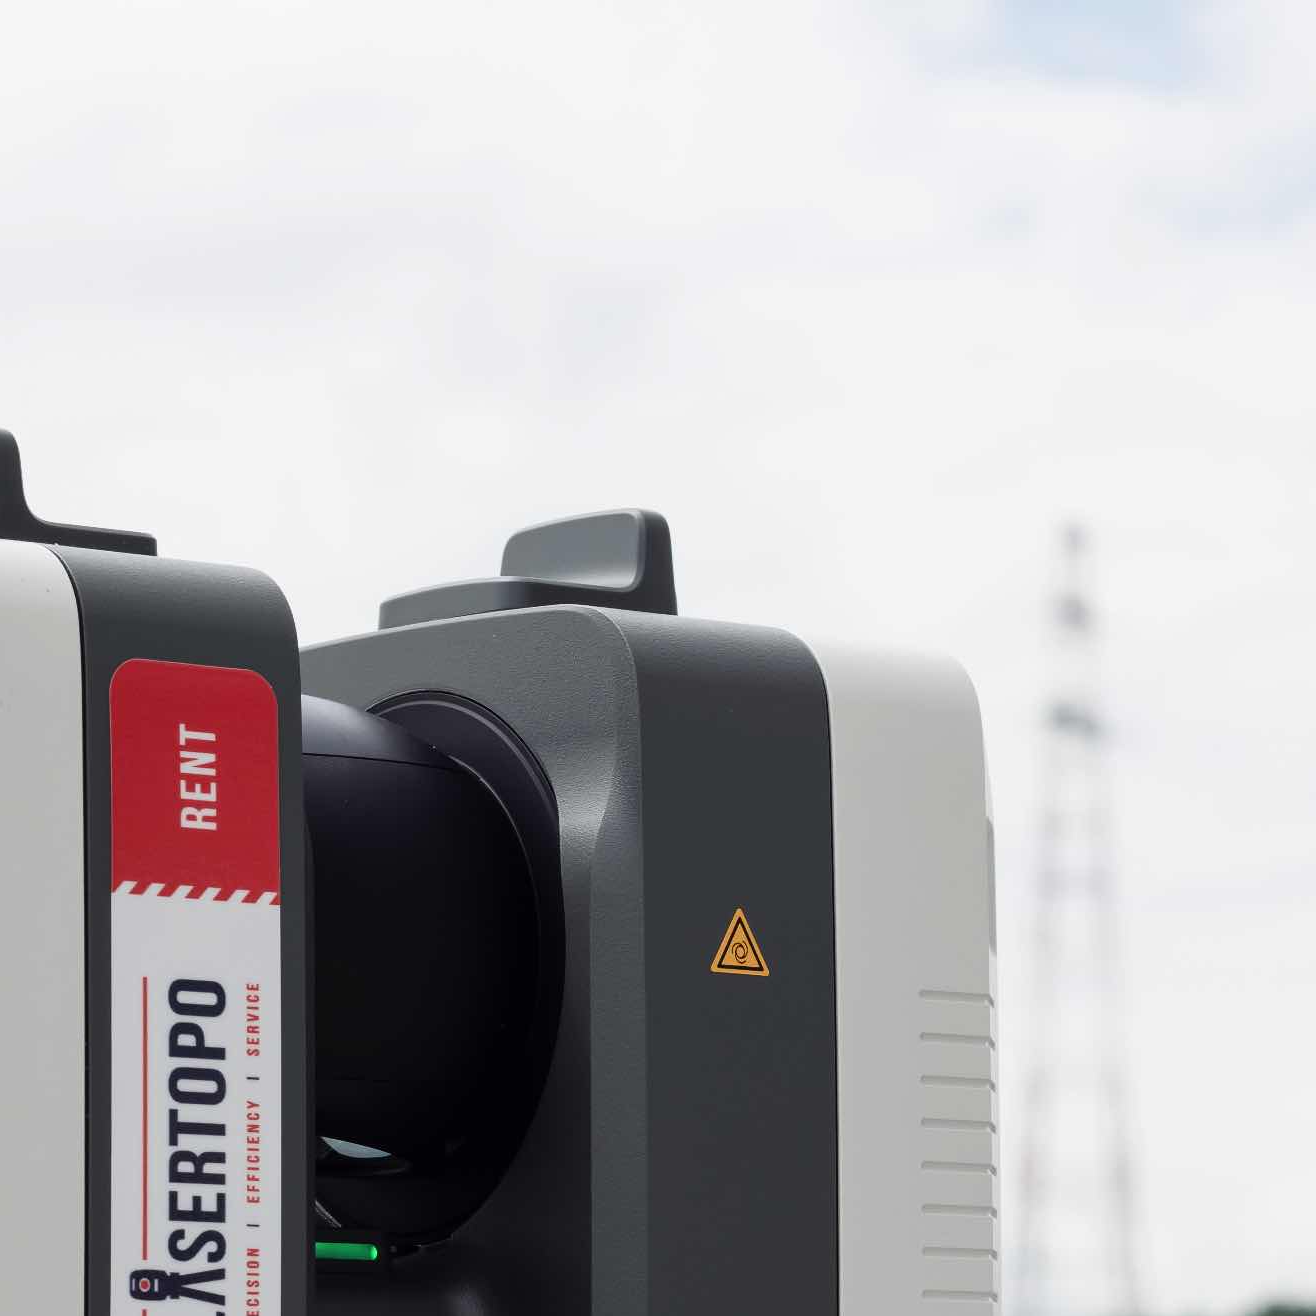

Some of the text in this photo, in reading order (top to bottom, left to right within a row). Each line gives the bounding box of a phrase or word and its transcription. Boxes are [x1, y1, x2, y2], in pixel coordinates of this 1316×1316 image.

[179, 723, 217, 831] RENT
[246, 983, 260, 1057] SERVICE
[246, 1100, 260, 1204] EFFICIENCY
